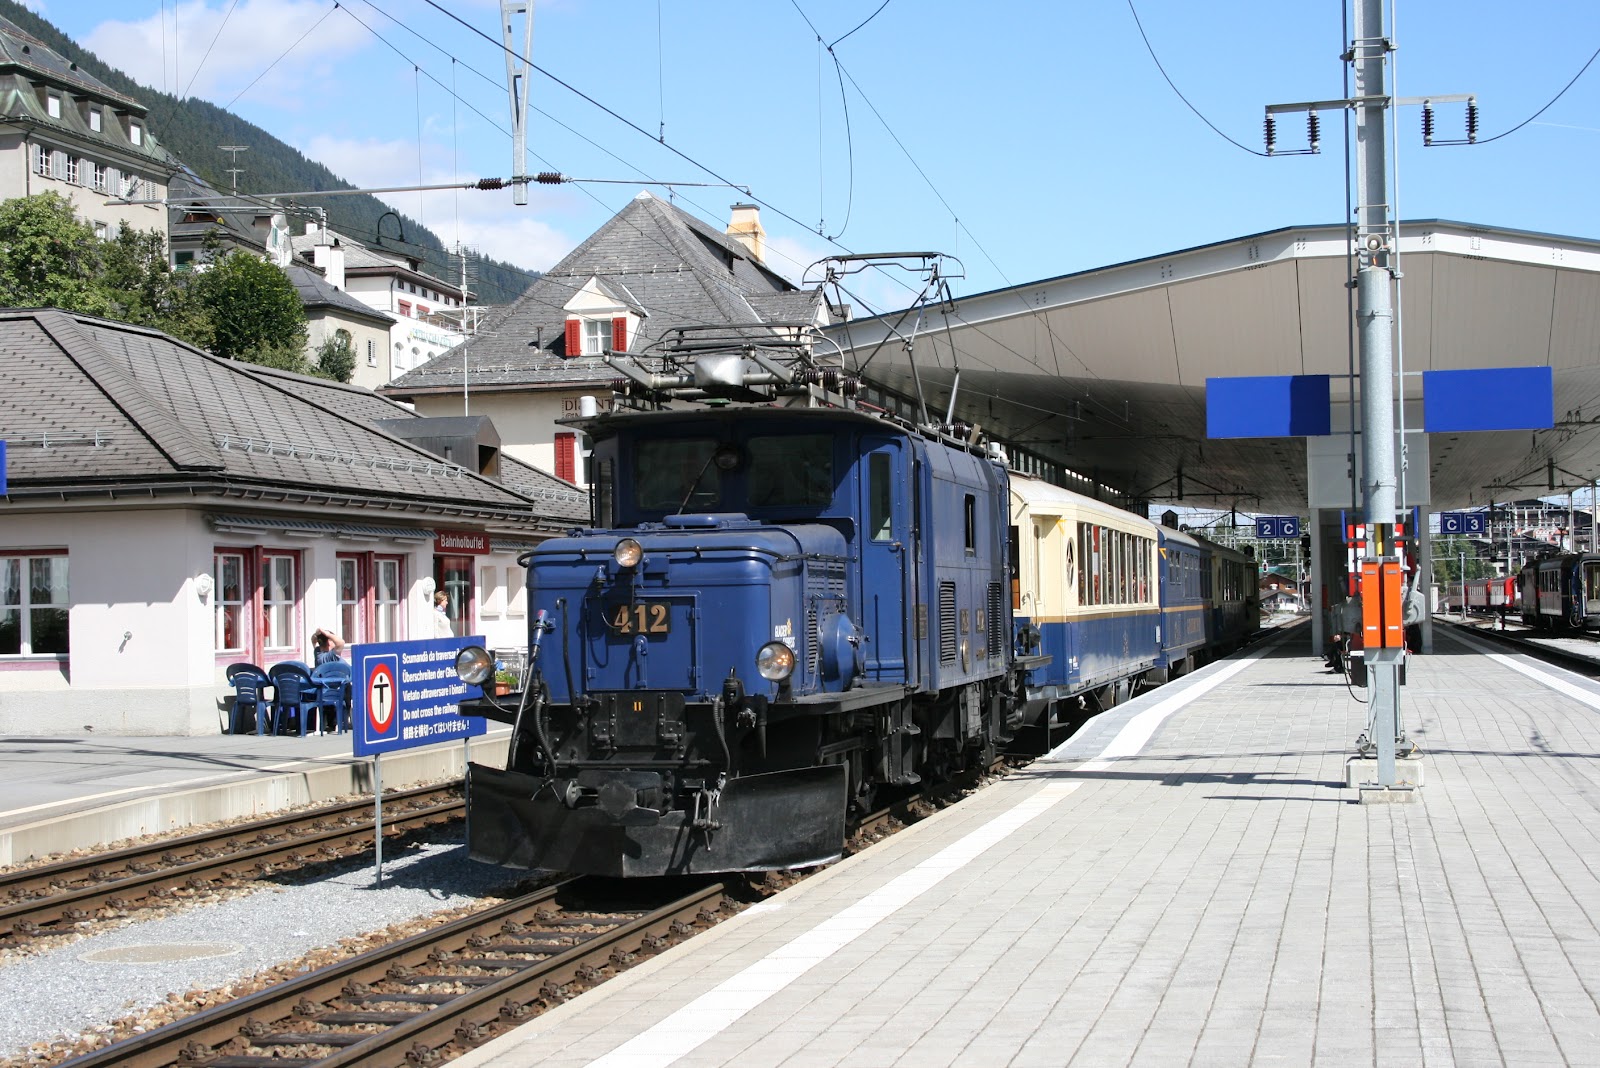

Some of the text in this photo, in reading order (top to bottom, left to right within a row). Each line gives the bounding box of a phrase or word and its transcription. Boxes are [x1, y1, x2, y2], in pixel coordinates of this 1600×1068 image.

[1263, 524, 1271, 534] 2
[1283, 523, 1294, 534] C
[1447, 519, 1457, 530] C
[1470, 519, 1479, 530] 3
[440, 534, 484, 549] Bahnhofbuffet
[614, 604, 668, 633] 412
[429, 651, 435, 661] da
[435, 650, 457, 661] traversar
[402, 669, 437, 683] Überschreiten
[436, 668, 446, 679] der
[402, 689, 421, 702] Vietato
[420, 688, 449, 700] attraversare
[402, 702, 459, 720] Do not cross the railway
